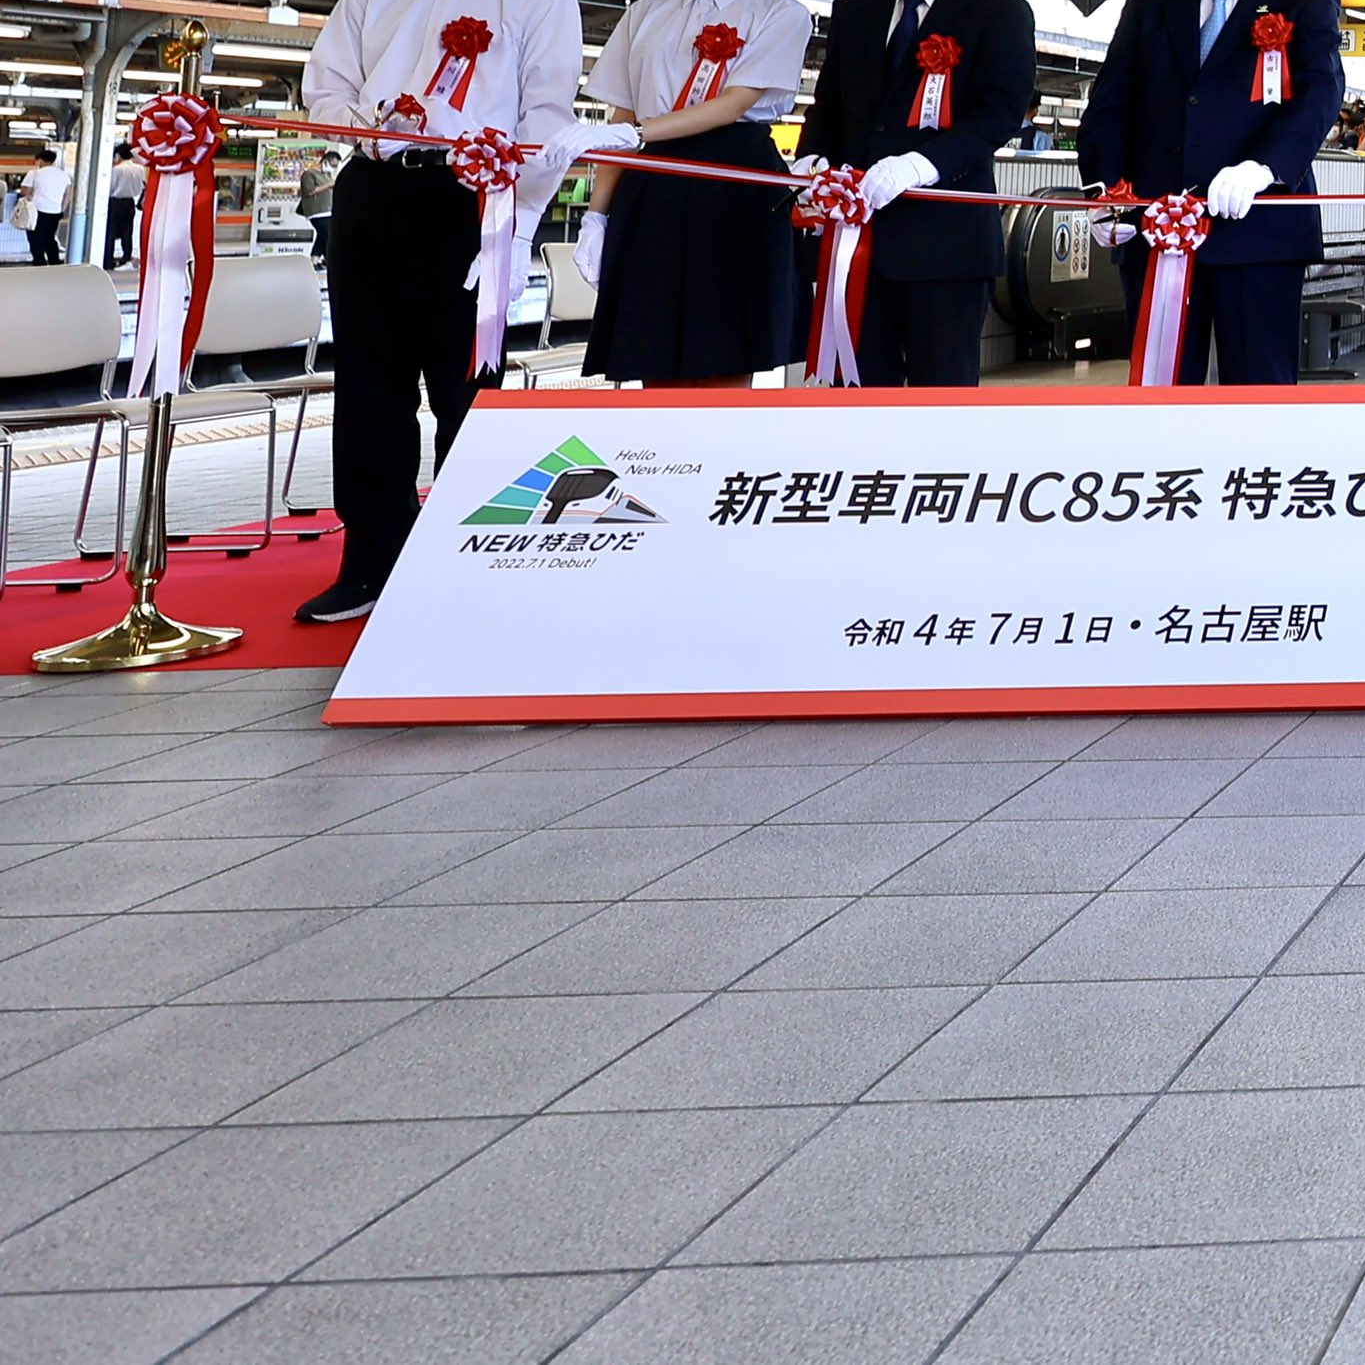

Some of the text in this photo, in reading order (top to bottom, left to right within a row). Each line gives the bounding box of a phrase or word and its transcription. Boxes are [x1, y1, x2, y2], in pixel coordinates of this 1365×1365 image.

[614, 449, 656, 462] Hello
[625, 463, 703, 476] New HIDA
[708, 467, 1205, 527] 新型車両HC85系
[458, 530, 646, 554] NEW 特急ひだ
[488, 557, 597, 570] 2022.7.1 Debut!
